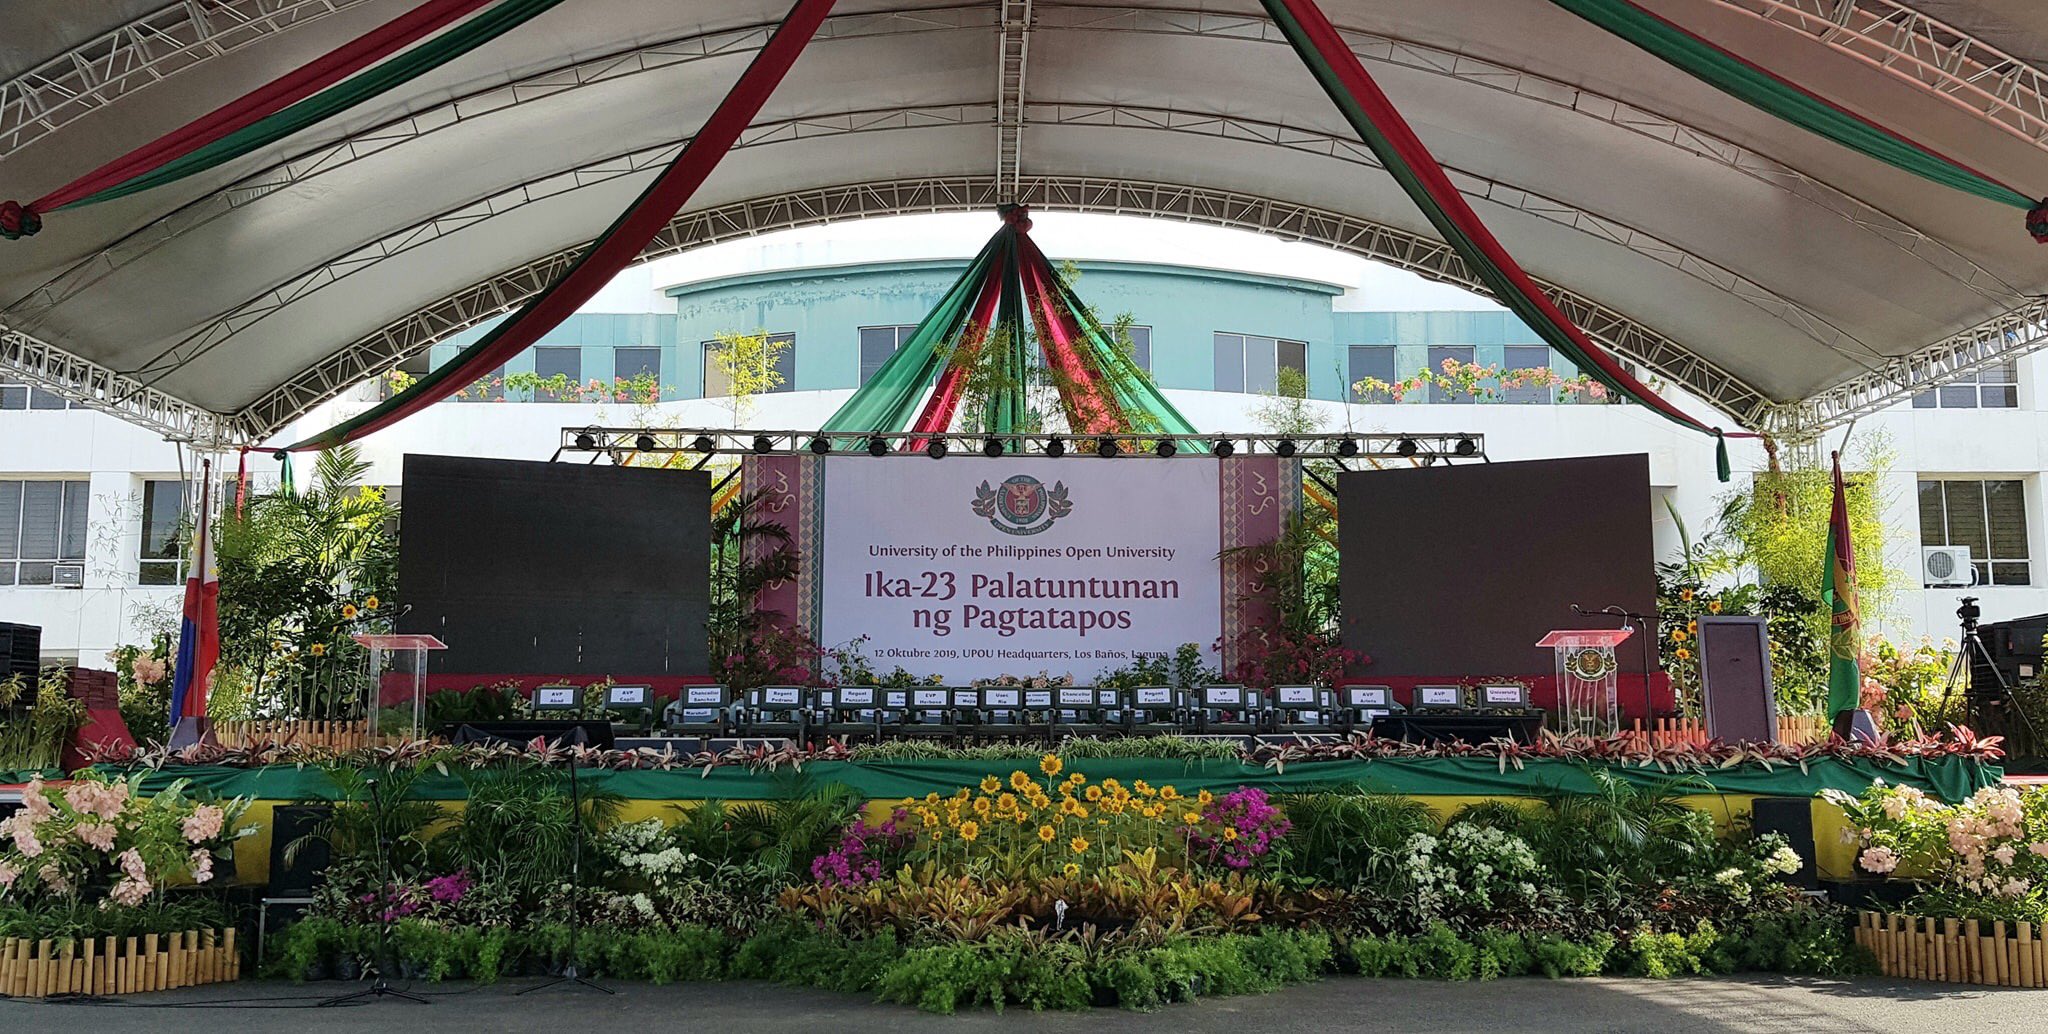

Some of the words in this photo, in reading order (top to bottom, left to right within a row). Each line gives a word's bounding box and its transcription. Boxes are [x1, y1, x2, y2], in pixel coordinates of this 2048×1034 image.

[870, 544, 938, 561] University
[942, 544, 957, 557] of
[960, 544, 982, 558] the
[987, 544, 1061, 561] Philippines
[1066, 546, 1101, 561] Open
[1106, 545, 1175, 561] University
[865, 570, 957, 601] Ika-23
[971, 571, 1179, 599] Palatuntunan
[912, 610, 952, 637] ng
[963, 604, 1132, 637] Pagtatapos
[874, 649, 884, 658] 12
[887, 648, 931, 658] Oktubre
[933, 649, 960, 659] 2019,
[962, 649, 994, 659] UPOU
[997, 648, 1072, 662] Headquarters,
[1074, 649, 1092, 659] Los
[1095, 649, 1129, 660] Baños,
